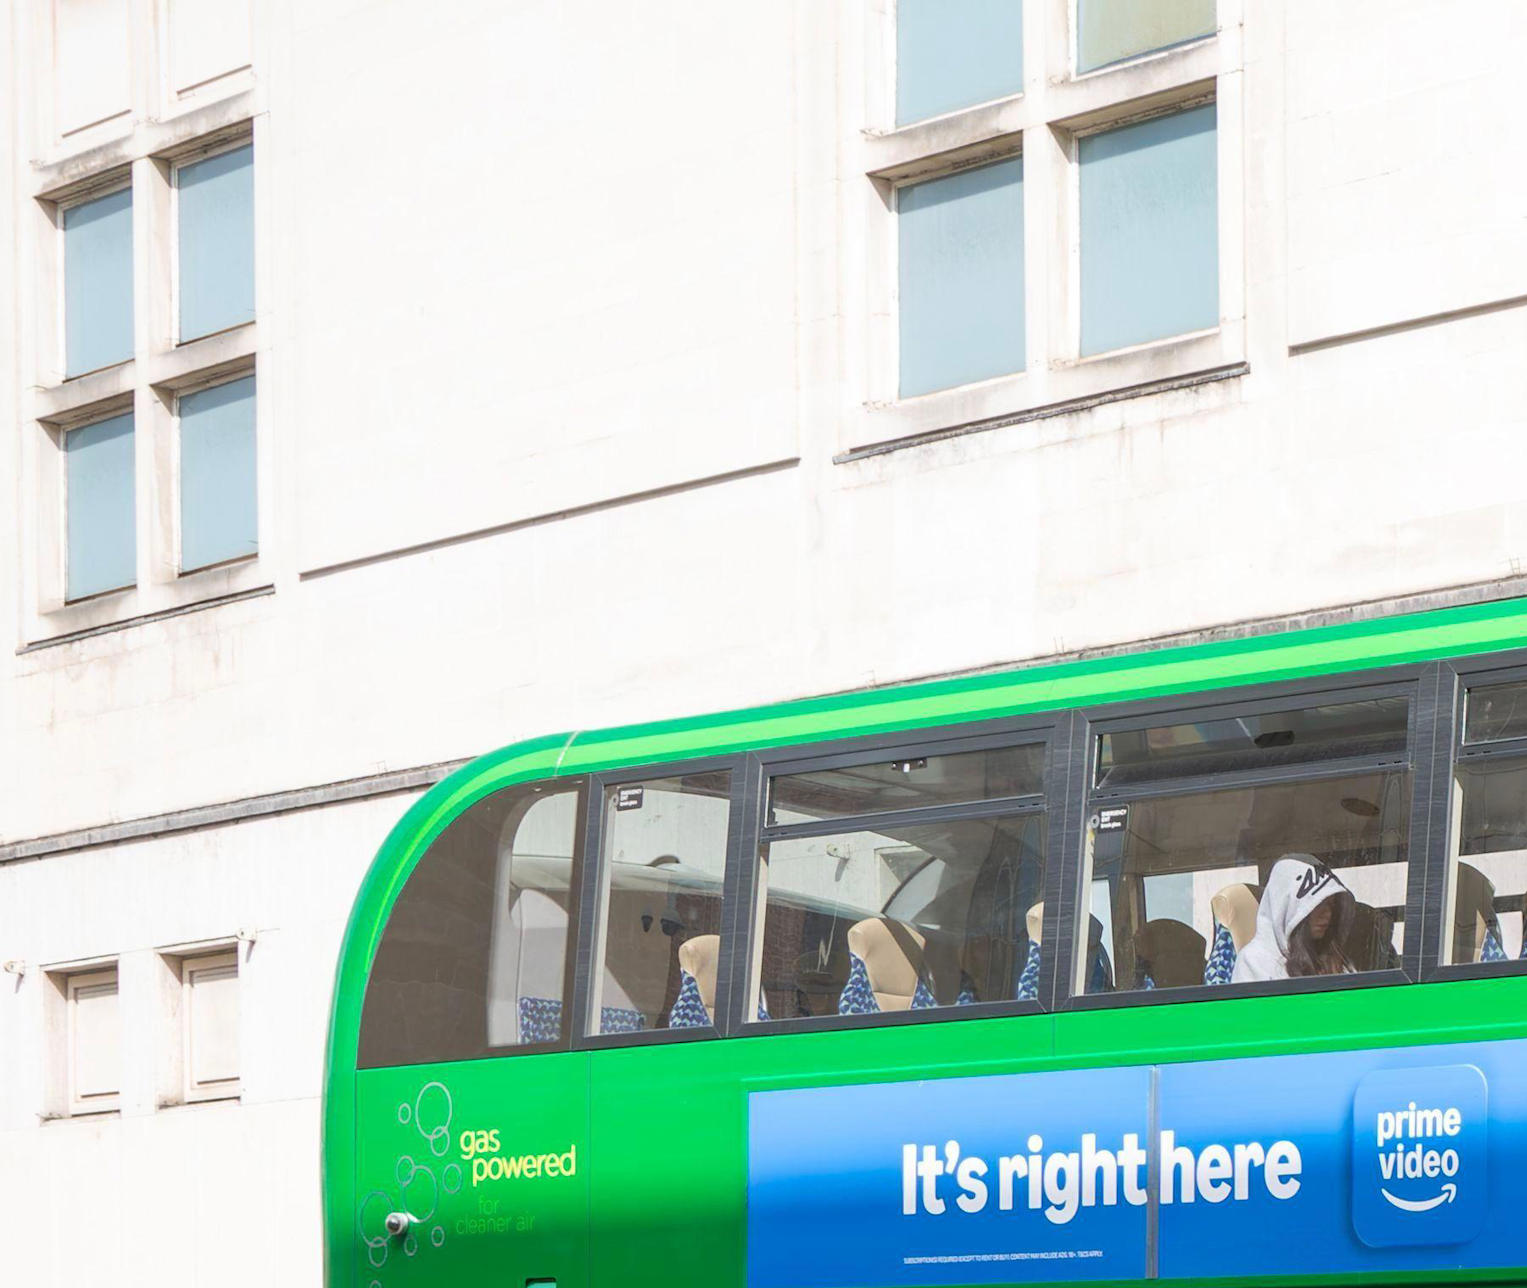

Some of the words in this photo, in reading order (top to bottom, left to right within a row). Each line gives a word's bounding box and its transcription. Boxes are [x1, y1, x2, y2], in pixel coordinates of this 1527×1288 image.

[460, 1128, 501, 1160] gas
[1377, 1102, 1461, 1148] prime
[472, 1143, 576, 1188] powered
[902, 1140, 988, 1215] It's
[999, 1134, 1147, 1225] right
[1160, 1130, 1303, 1204] here
[1378, 1143, 1460, 1181] video
[456, 1215, 512, 1235] cleaner
[515, 1211, 536, 1233] air
[479, 1194, 499, 1215] for
